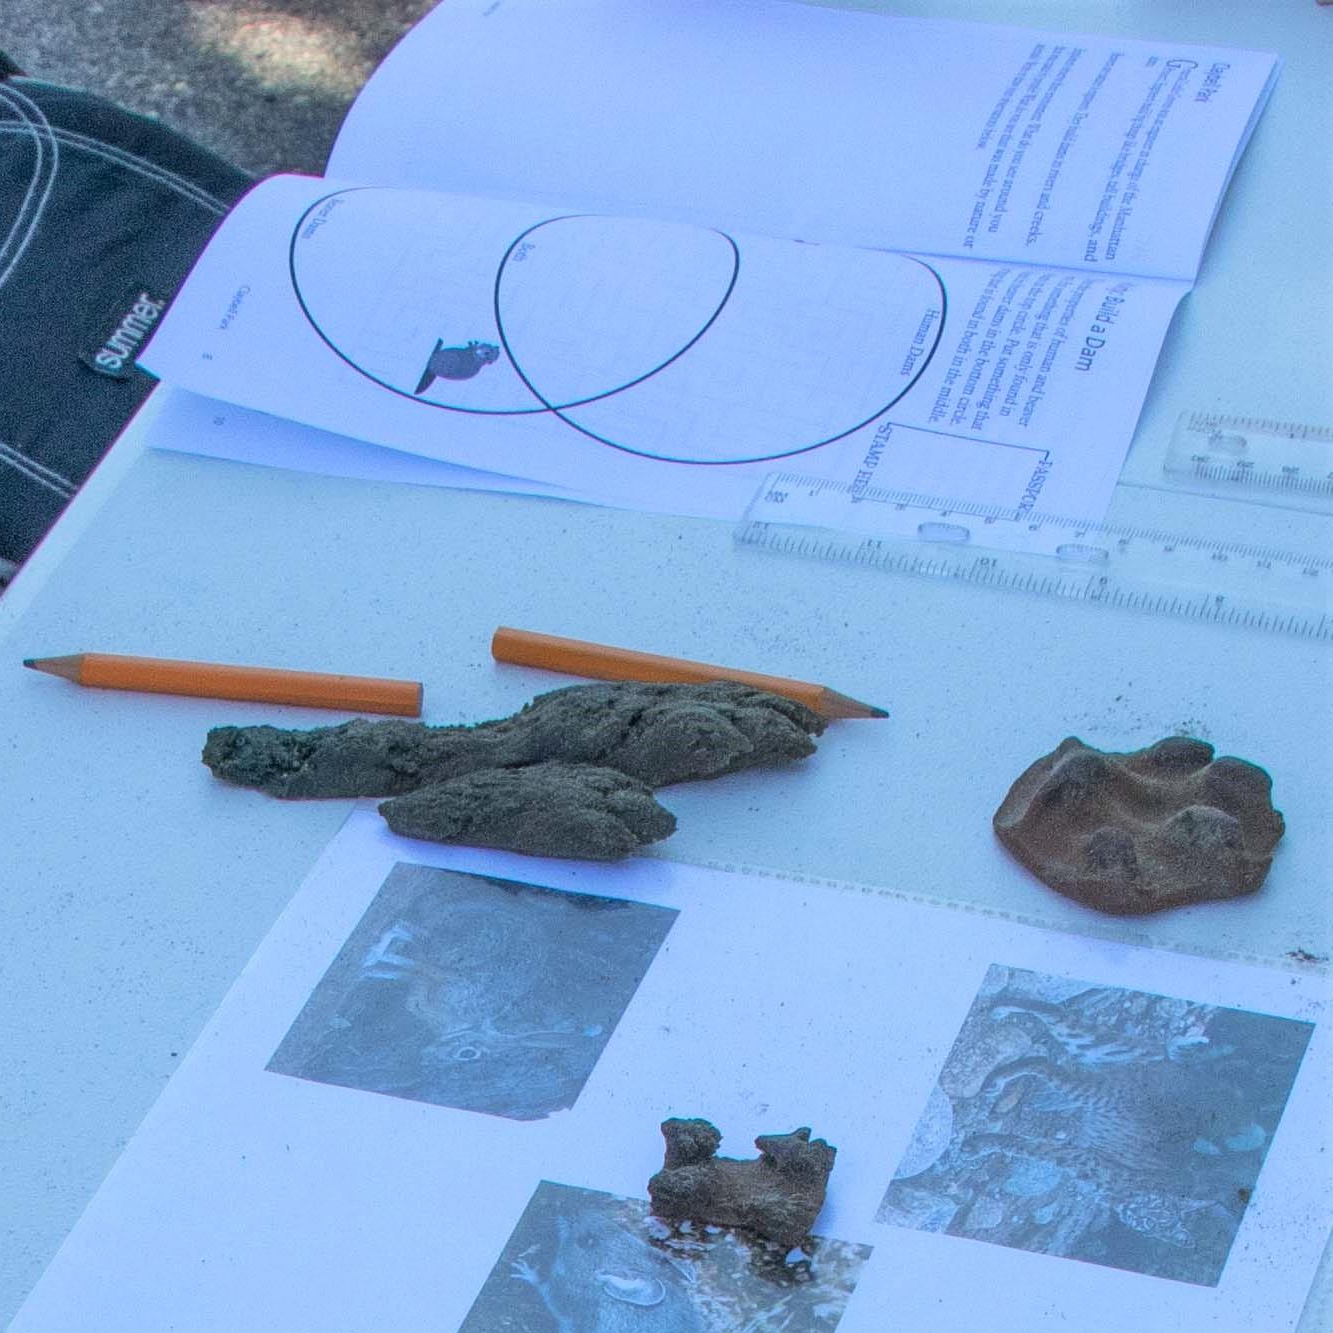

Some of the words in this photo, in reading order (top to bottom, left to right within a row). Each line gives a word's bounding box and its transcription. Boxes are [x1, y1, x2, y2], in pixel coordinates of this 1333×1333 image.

[1083, 239, 1098, 263] and
[1095, 296, 1125, 324] Build
[913, 308, 940, 345] Human
[1029, 321, 1049, 340] that
[1089, 324, 1106, 334] a
[956, 330, 979, 354] both
[978, 339, 995, 357] the
[1001, 337, 1020, 356] Put
[1039, 338, 1064, 373] human
[1076, 336, 1106, 372] Dam
[900, 345, 924, 376] Dams
[1014, 350, 1034, 374] only
[943, 367, 961, 386] the
[963, 358, 989, 396] bottom
[976, 357, 1008, 409] something
[1004, 374, 1028, 406] found
[1031, 373, 1047, 395] and
[928, 386, 952, 423] middle.
[950, 396, 970, 425] circle.
[1018, 395, 1042, 427] beaver
[970, 410, 990, 431] that
[864, 425, 892, 468] STAMP
[978, 556, 998, 568] 10
